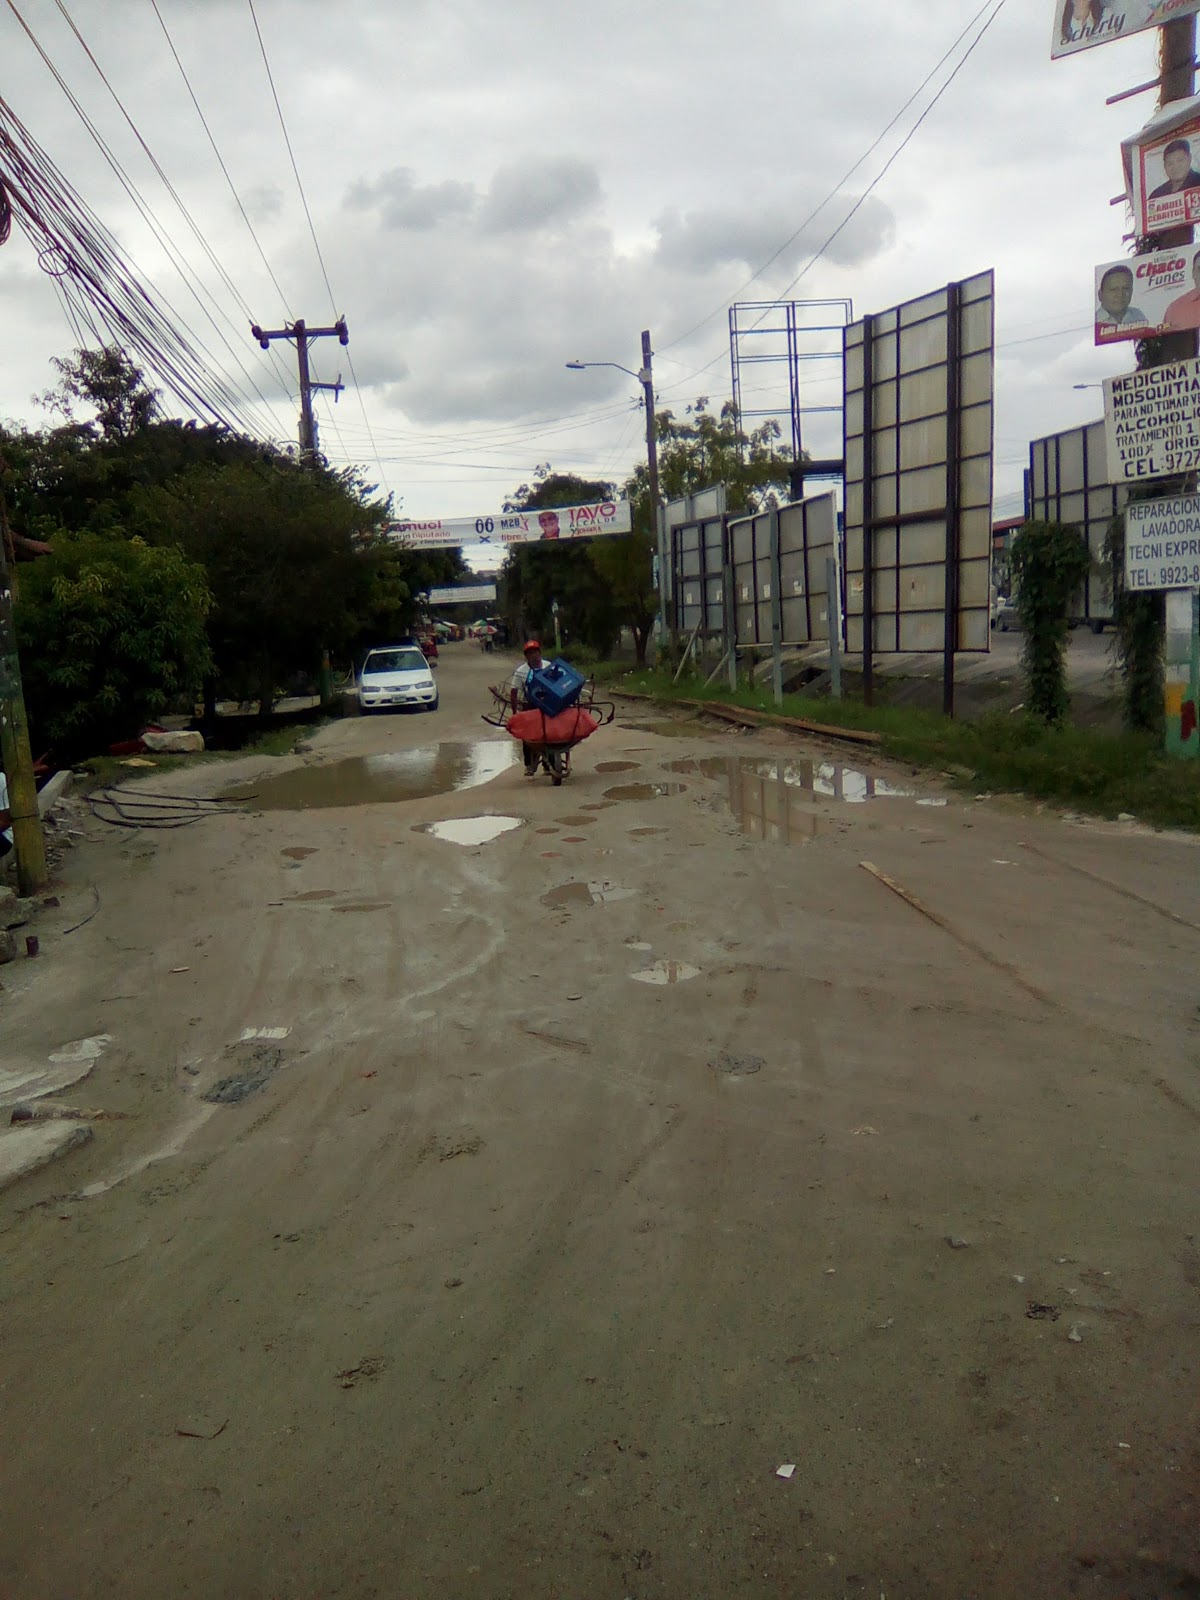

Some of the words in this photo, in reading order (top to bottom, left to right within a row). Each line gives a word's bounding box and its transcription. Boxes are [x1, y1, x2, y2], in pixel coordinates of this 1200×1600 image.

[1136, 258, 1187, 278] Chaco
[1148, 270, 1185, 286] Funes
[1112, 365, 1188, 393] MEDICINA
[1113, 378, 1200, 408] MOSQUITIA
[1114, 408, 1138, 421] PARA
[1140, 403, 1153, 415] NO
[1155, 396, 1189, 412] TOMAR
[1116, 424, 1182, 447] TRATAMIENTO
[1187, 423, 1194, 434] 1
[1120, 443, 1154, 460] 100%
[567, 502, 616, 520] TAVO
[570, 517, 615, 528] ALCALDE
[1142, 518, 1200, 538] LAVADORA
[412, 531, 451, 539] Diputado
[1130, 543, 1162, 560] TECNI
[1166, 539, 1200, 557] EXPR
[1130, 569, 1156, 587] TEL:
[1160, 565, 1200, 584] 9923-8
